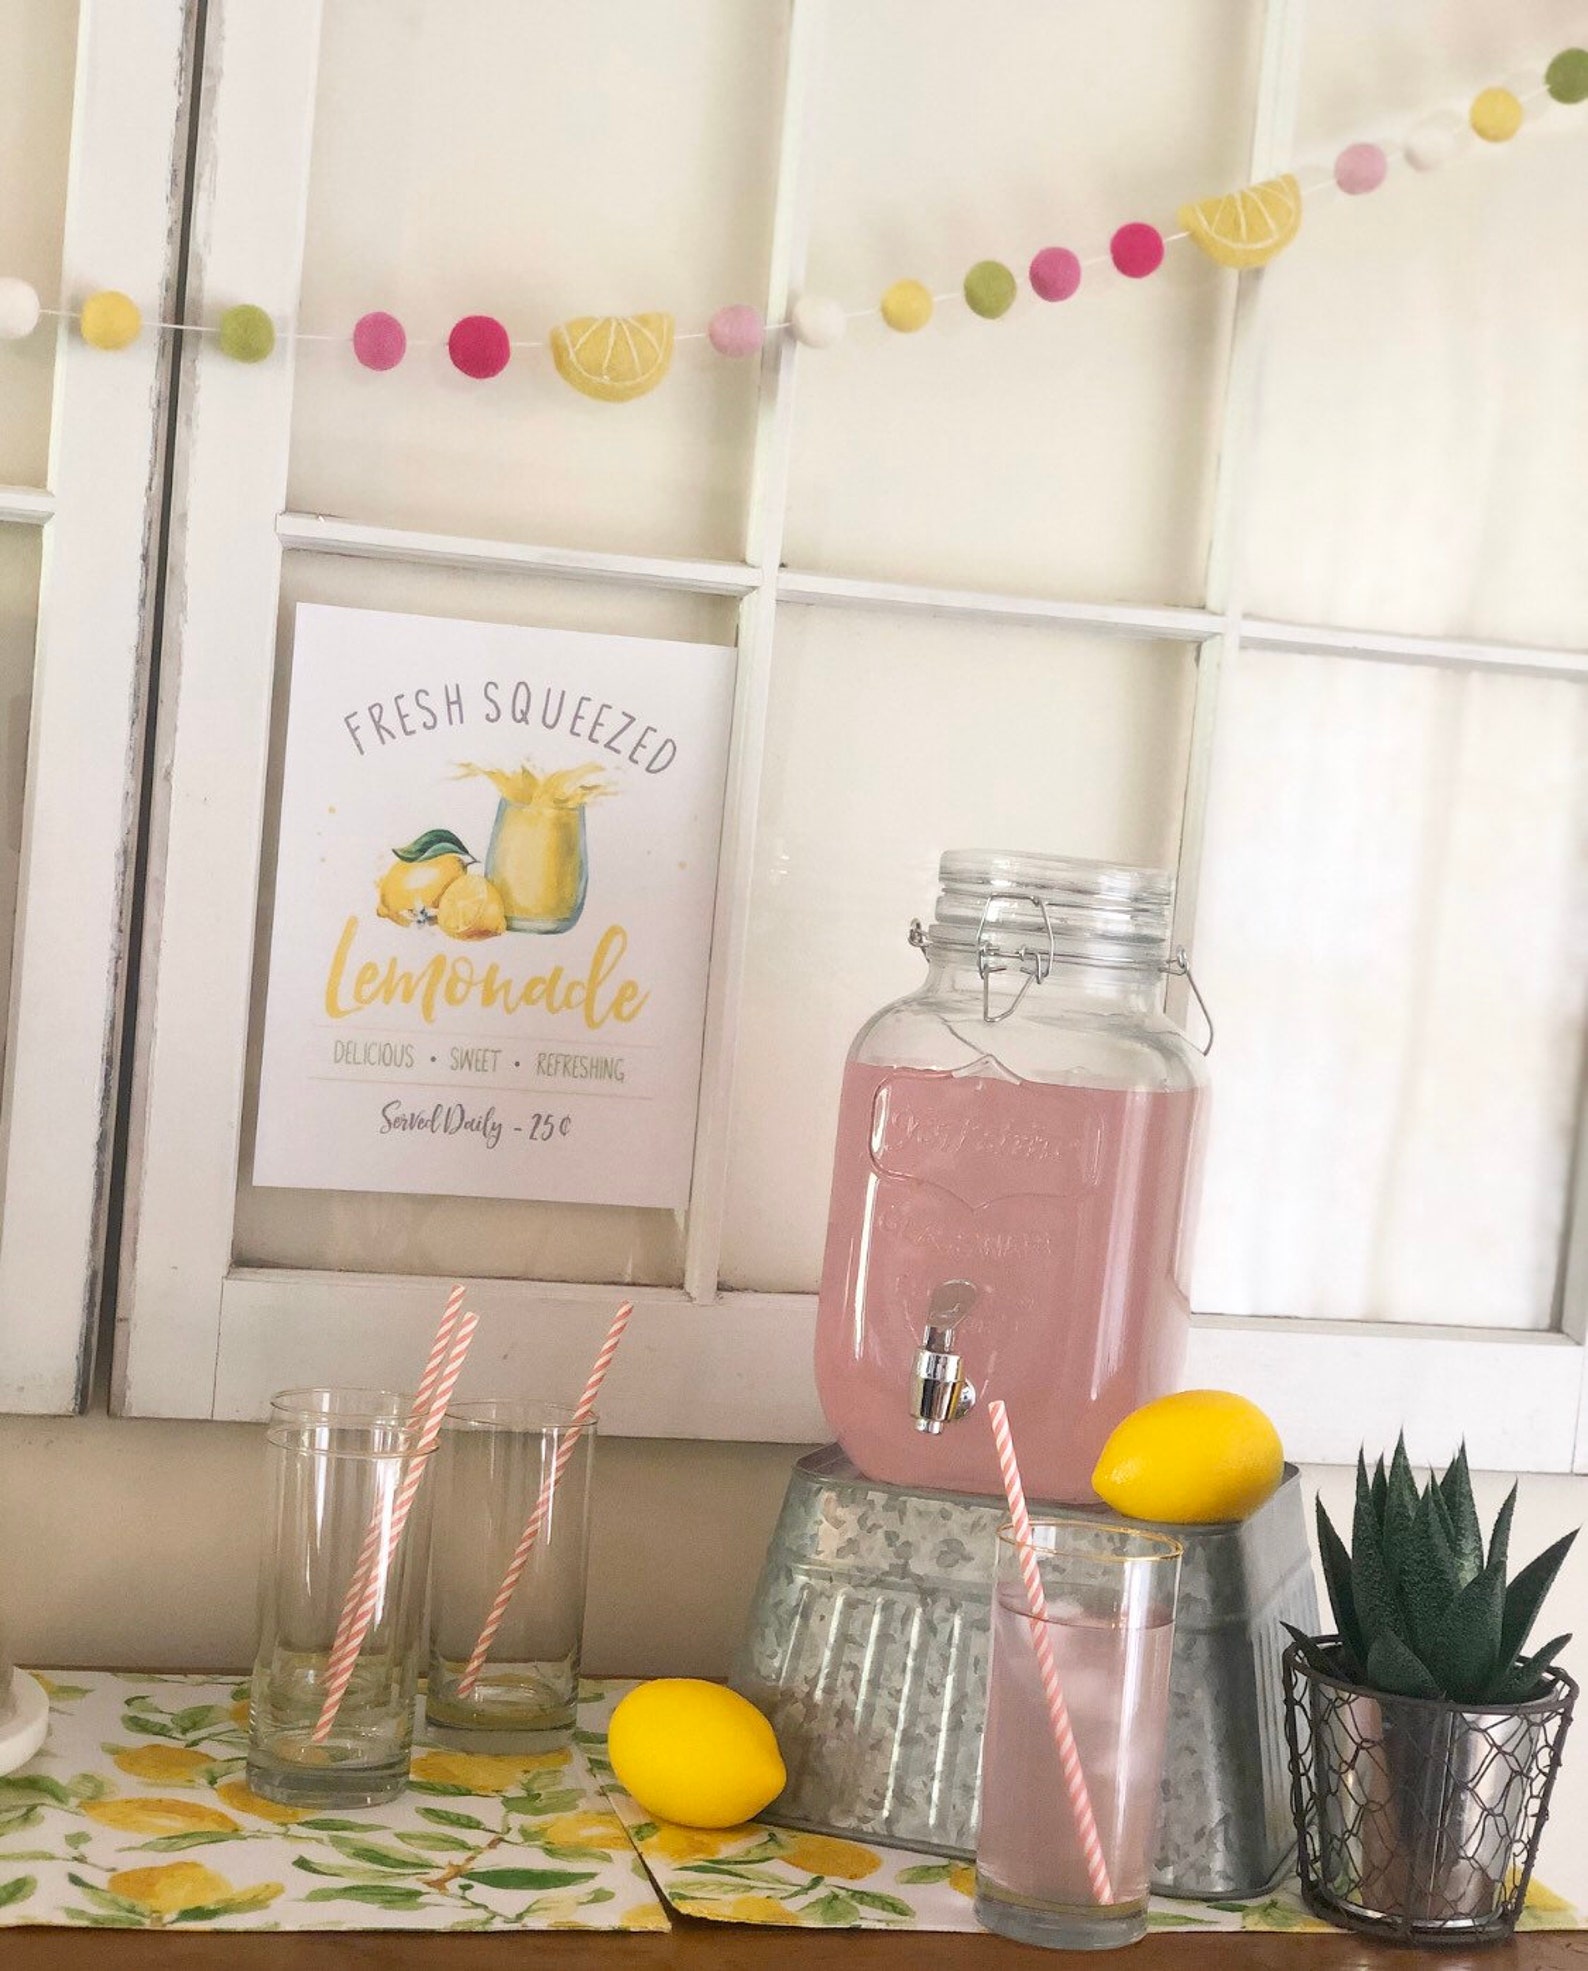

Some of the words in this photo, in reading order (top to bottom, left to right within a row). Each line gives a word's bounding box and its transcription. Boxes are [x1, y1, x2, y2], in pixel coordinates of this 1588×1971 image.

[344, 683, 465, 756] FRESH
[483, 680, 677, 774] SQUEEZED
[324, 914, 651, 1030] Lemonade
[332, 1039, 415, 1069] DELICIOUS
[450, 1046, 502, 1073] SWEET
[535, 1052, 625, 1083] REFRESHING
[379, 1100, 444, 1134] Served
[444, 1103, 503, 1150] Daily
